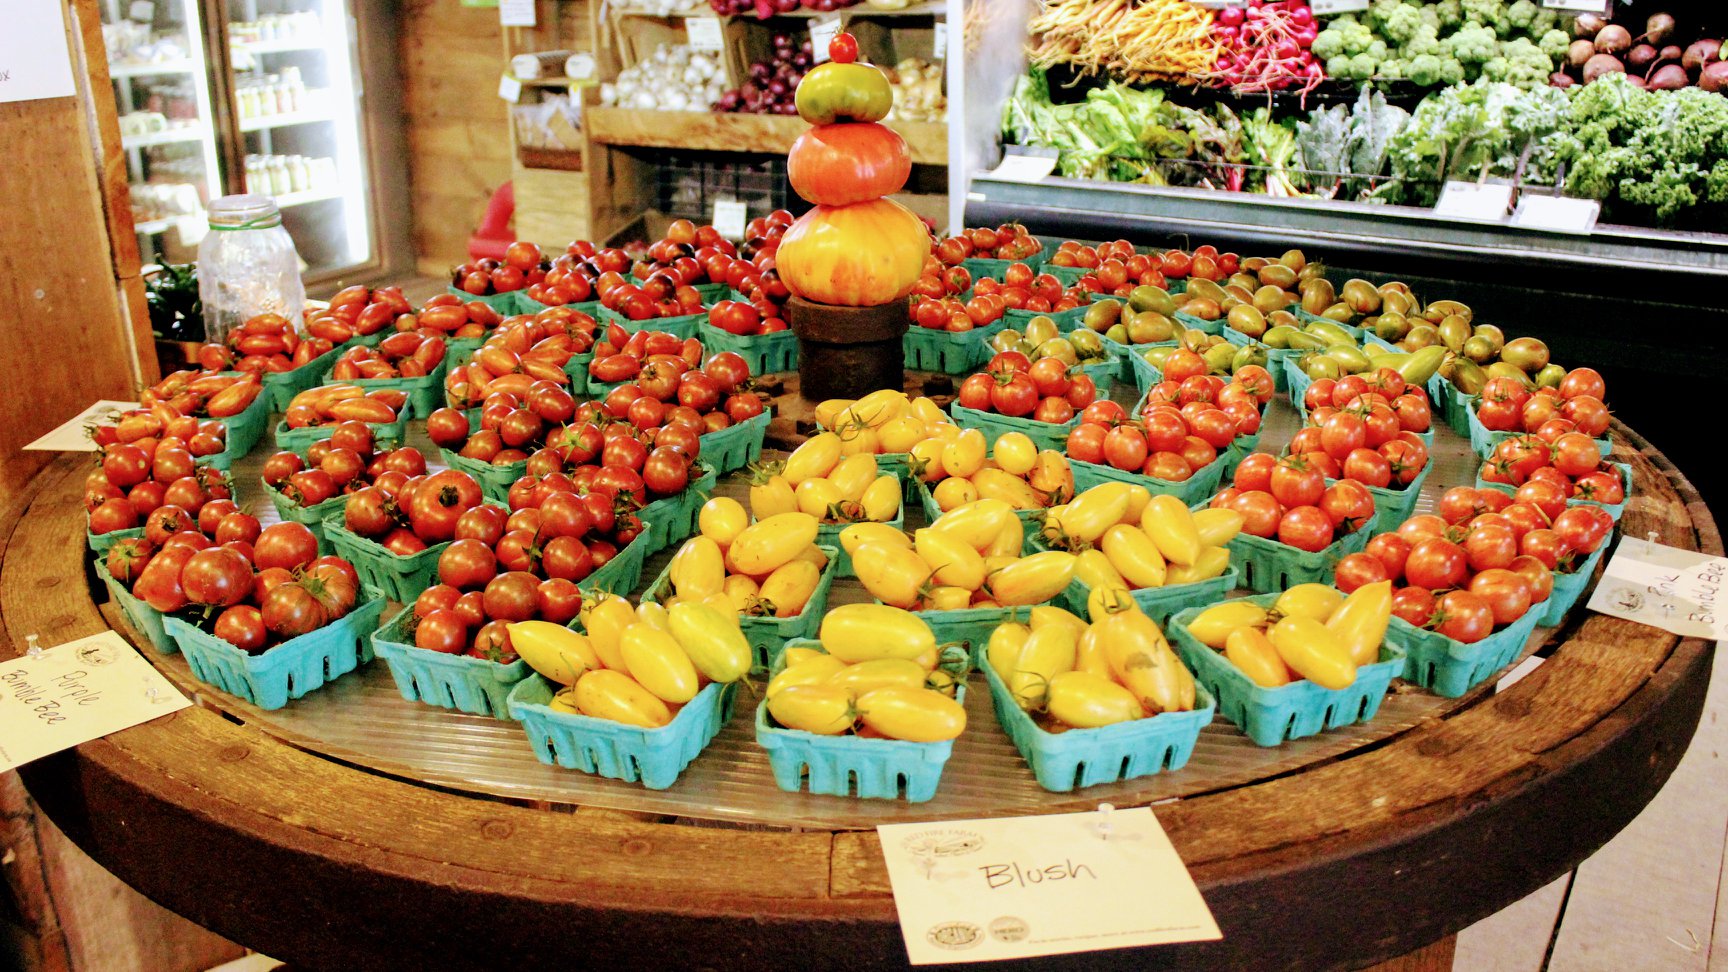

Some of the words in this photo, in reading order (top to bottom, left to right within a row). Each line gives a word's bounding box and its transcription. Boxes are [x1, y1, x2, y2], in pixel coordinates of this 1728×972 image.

[2, 669, 47, 704] Bumble
[34, 700, 67, 725] Bee
[51, 670, 102, 706] Purple
[978, 859, 1096, 889] Blush
